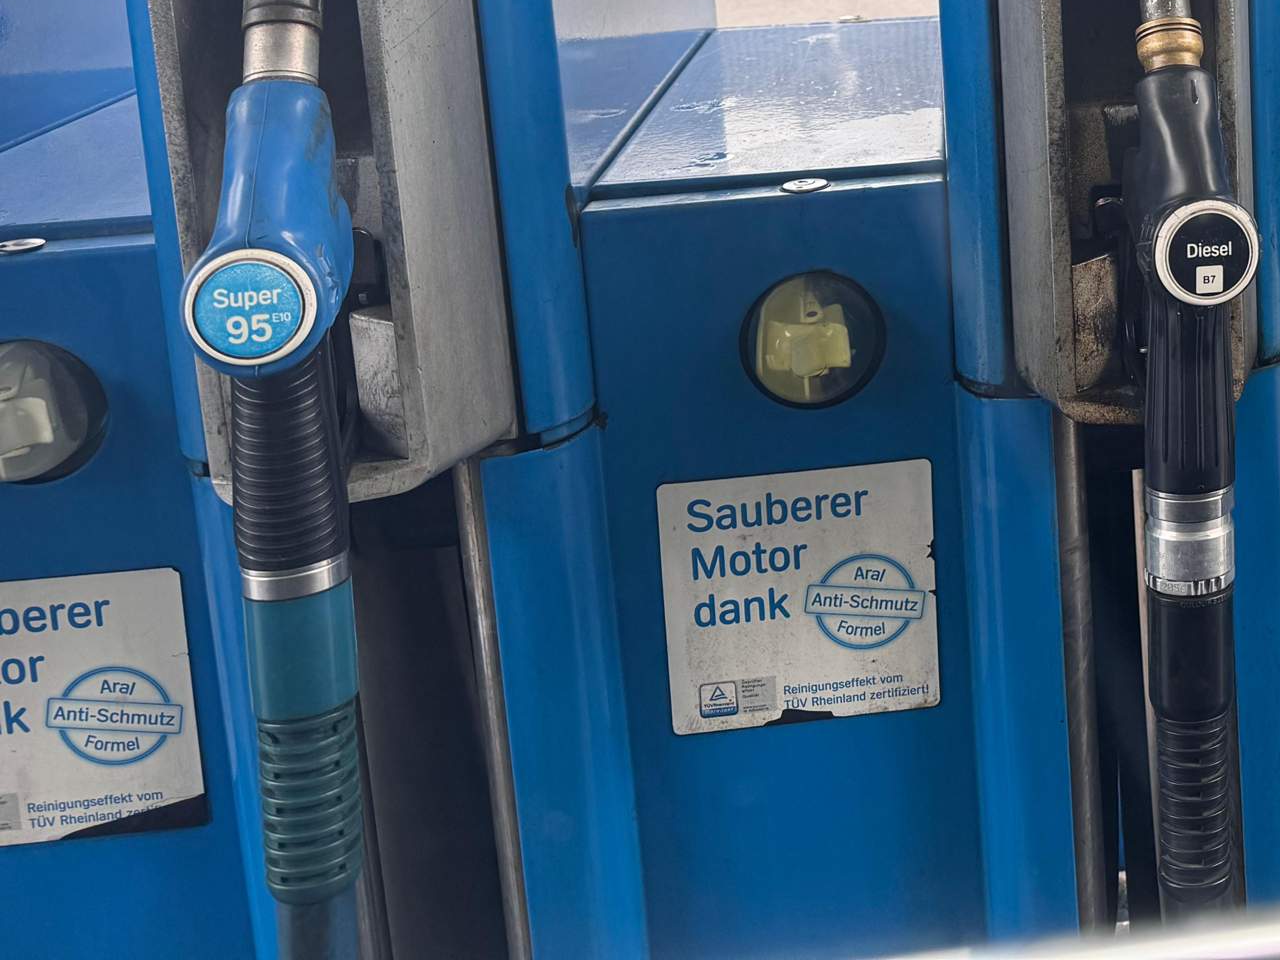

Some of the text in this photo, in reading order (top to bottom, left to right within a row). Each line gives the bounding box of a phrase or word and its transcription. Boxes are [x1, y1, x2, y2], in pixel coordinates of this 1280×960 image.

[1186, 241, 1233, 258] Diesel
[1203, 275, 1216, 285] B7
[213, 288, 282, 311] Super
[226, 312, 292, 345] 95 E10
[686, 490, 869, 533] Sauberer
[690, 542, 808, 581] Motor
[854, 566, 886, 583] Aral
[694, 587, 792, 628] dank
[811, 591, 919, 612] Anti-Schmutz
[837, 620, 886, 638] Formel
[0, 654, 45, 685] or
[100, 678, 136, 696] Aral
[783, 673, 904, 697] Reinigungseffekt vom
[784, 696, 808, 710] TÜV
[811, 691, 867, 707] Rheinland
[869, 683, 930, 701] zertifiziert!
[53, 706, 176, 726] Anti-Schmutz
[84, 734, 140, 752] Formel
[27, 792, 134, 814] Reinigungseffekt
[136, 790, 164, 801] vom
[30, 814, 56, 829] TÜV
[60, 809, 122, 826] Rheinland
